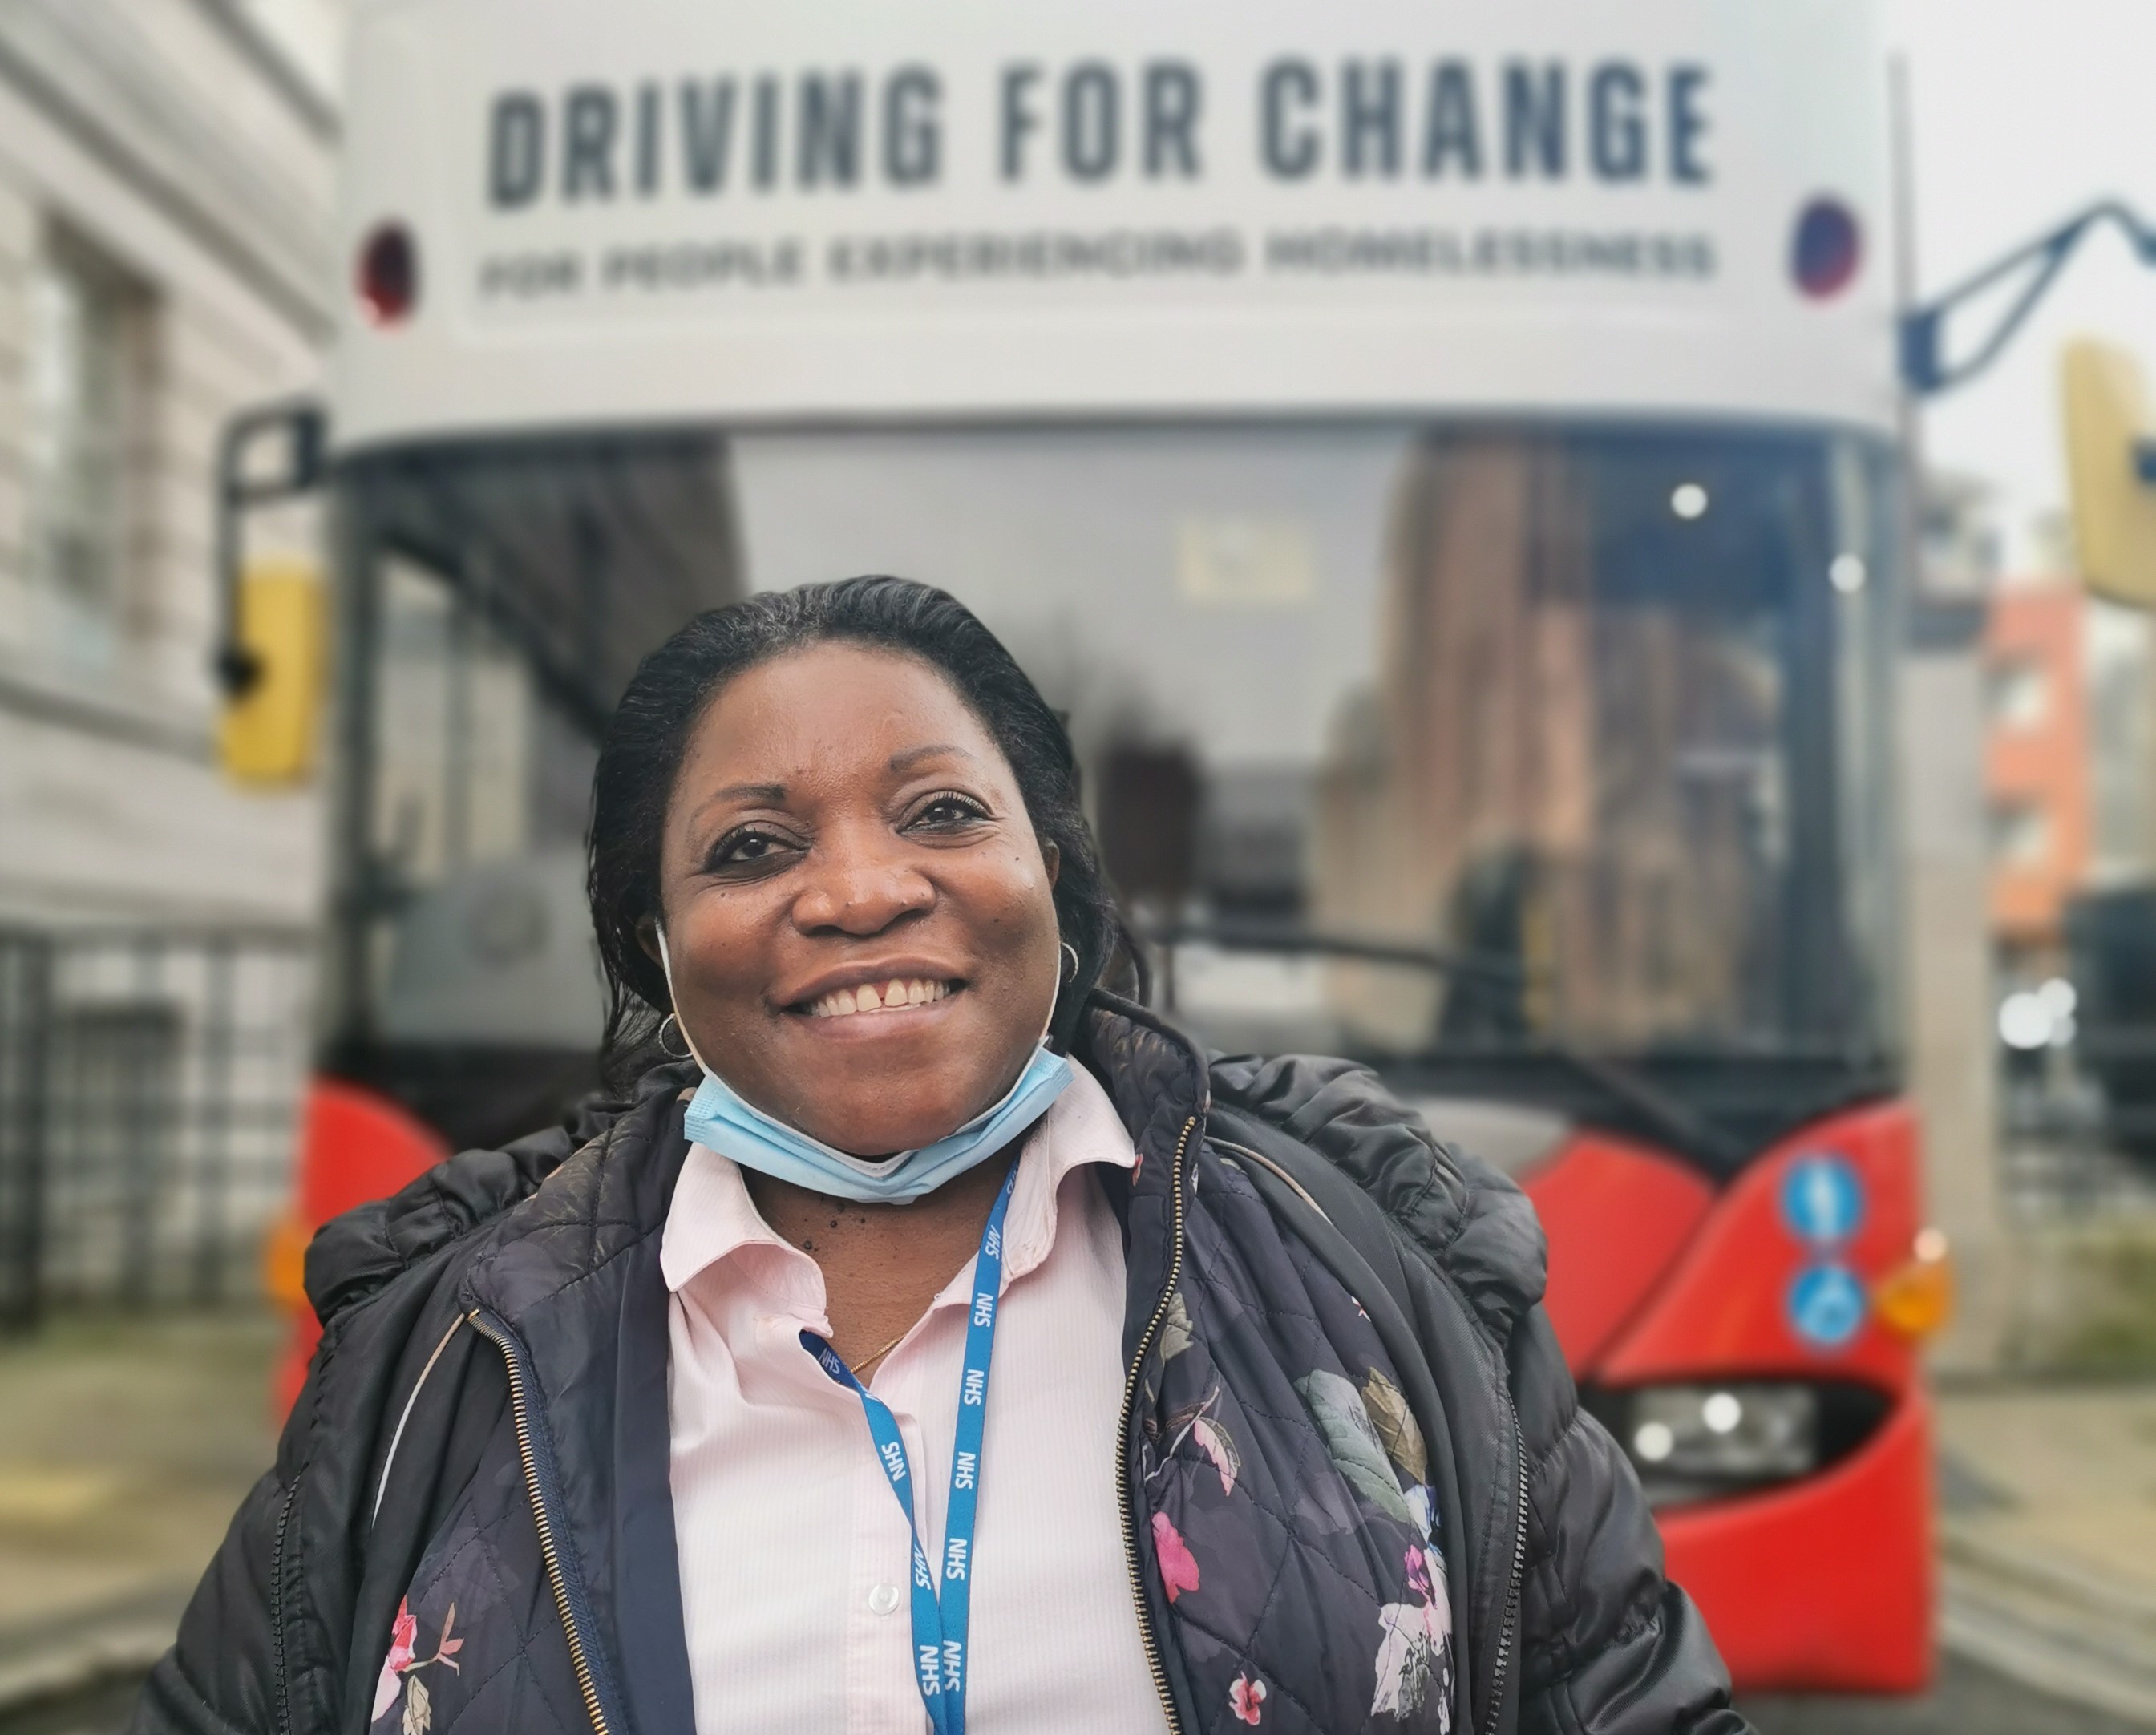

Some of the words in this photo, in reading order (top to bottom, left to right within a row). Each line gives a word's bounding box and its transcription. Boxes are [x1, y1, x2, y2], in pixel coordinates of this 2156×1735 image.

[488, 63, 944, 211] DRIVING
[1000, 59, 1201, 185] FOR
[1257, 55, 1713, 186] CHANGE
[479, 249, 585, 298] FOR
[601, 236, 803, 289] PEOPLE
[830, 228, 1244, 282] EXPERIENCING
[1265, 224, 1716, 279] HOMELESSNESS
[985, 1225, 1001, 1260] NHS
[974, 1292, 993, 1328] NHS
[818, 1348, 840, 1374] NHS
[964, 1369, 984, 1406] NHS
[881, 1441, 906, 1482] NHS
[955, 1451, 976, 1490] NHS
[913, 1544, 932, 1591] NHS
[946, 1538, 967, 1580] NHS
[920, 1644, 940, 1697] NHS
[943, 1640, 961, 1692] NHS
